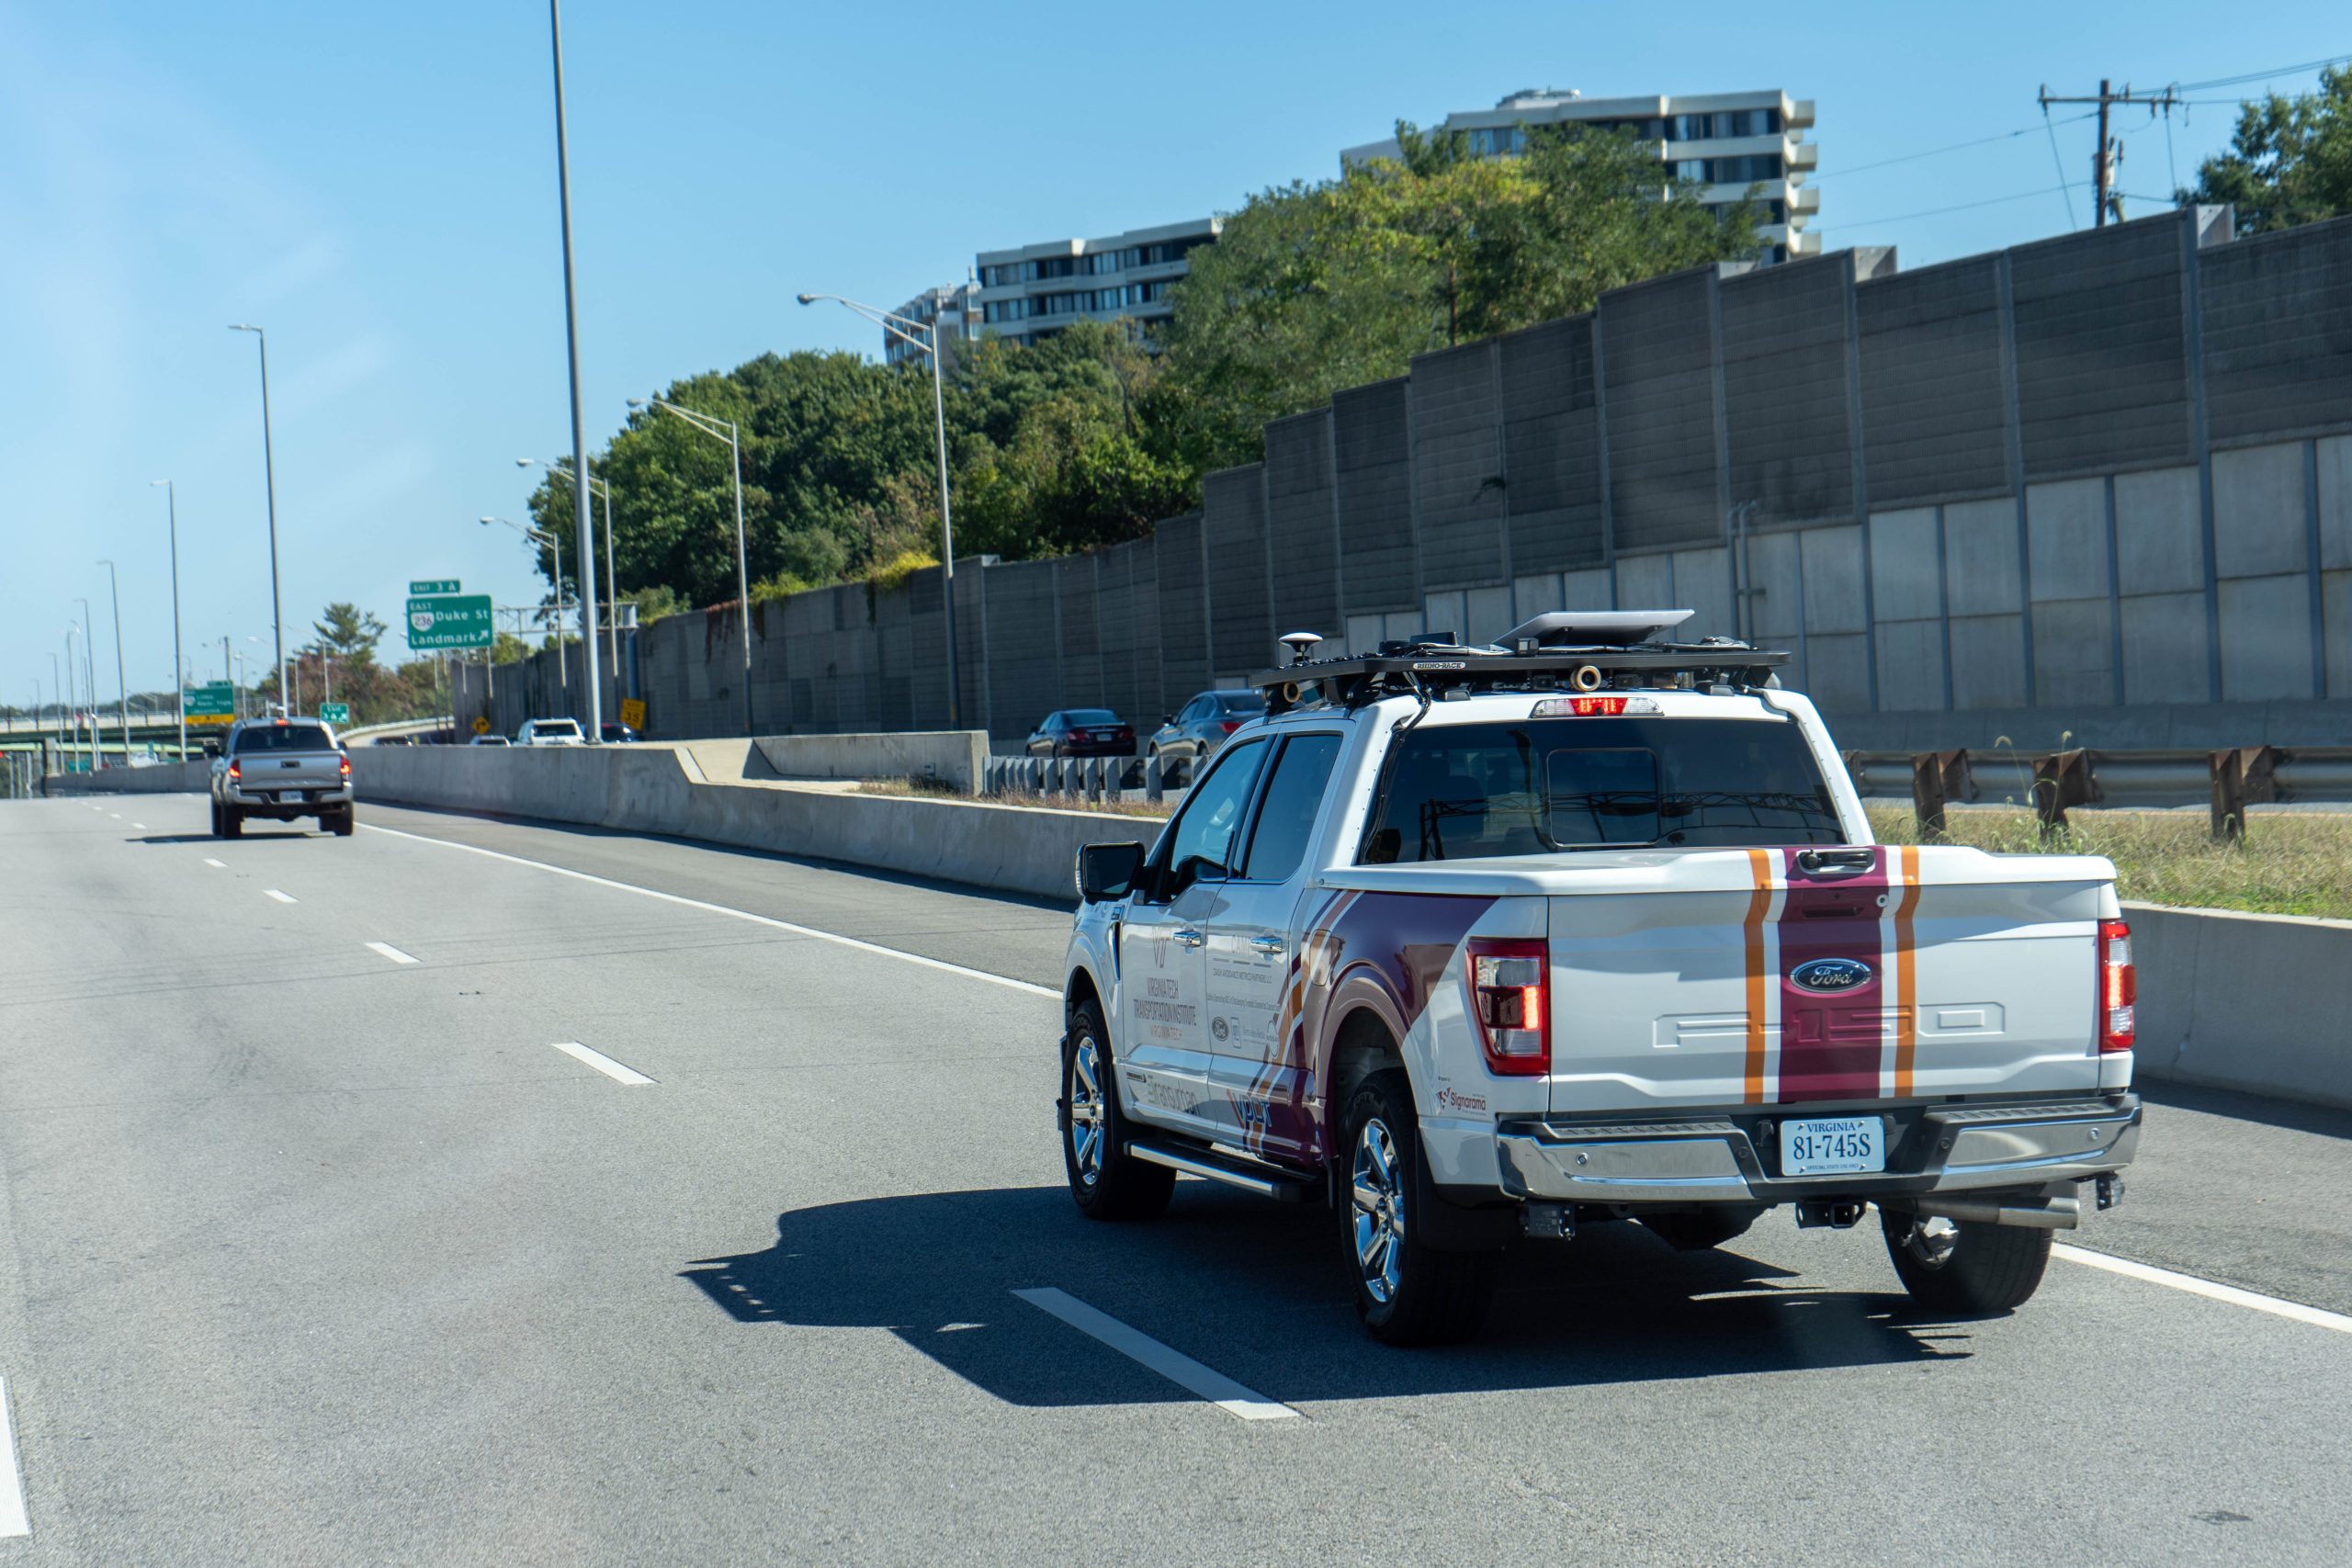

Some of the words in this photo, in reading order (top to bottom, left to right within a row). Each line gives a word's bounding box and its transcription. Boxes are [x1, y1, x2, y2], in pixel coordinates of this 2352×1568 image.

[414, 583, 430, 592] EXIT
[437, 582, 443, 592] 3
[448, 581, 456, 591] A
[410, 602, 432, 611] EAST
[414, 616, 433, 626] 236
[435, 610, 469, 621] Duke
[475, 609, 489, 619] St
[411, 632, 476, 645] Landmark
[625, 711, 640, 723] 35
[1810, 965, 1854, 986] Ford
[1166, 978, 1180, 999] TECH
[1134, 998, 1172, 1023] TRANSPORTATION
[1173, 1003, 1197, 1026] INSTITUTE
[1653, 1002, 2006, 1048] F-150
[1227, 1089, 1272, 1128] VDOT
[1451, 1091, 1487, 1111] Signarama
[1807, 1122, 1856, 1133] VIRGINIA
[1793, 1134, 1871, 1159] 81-745S
